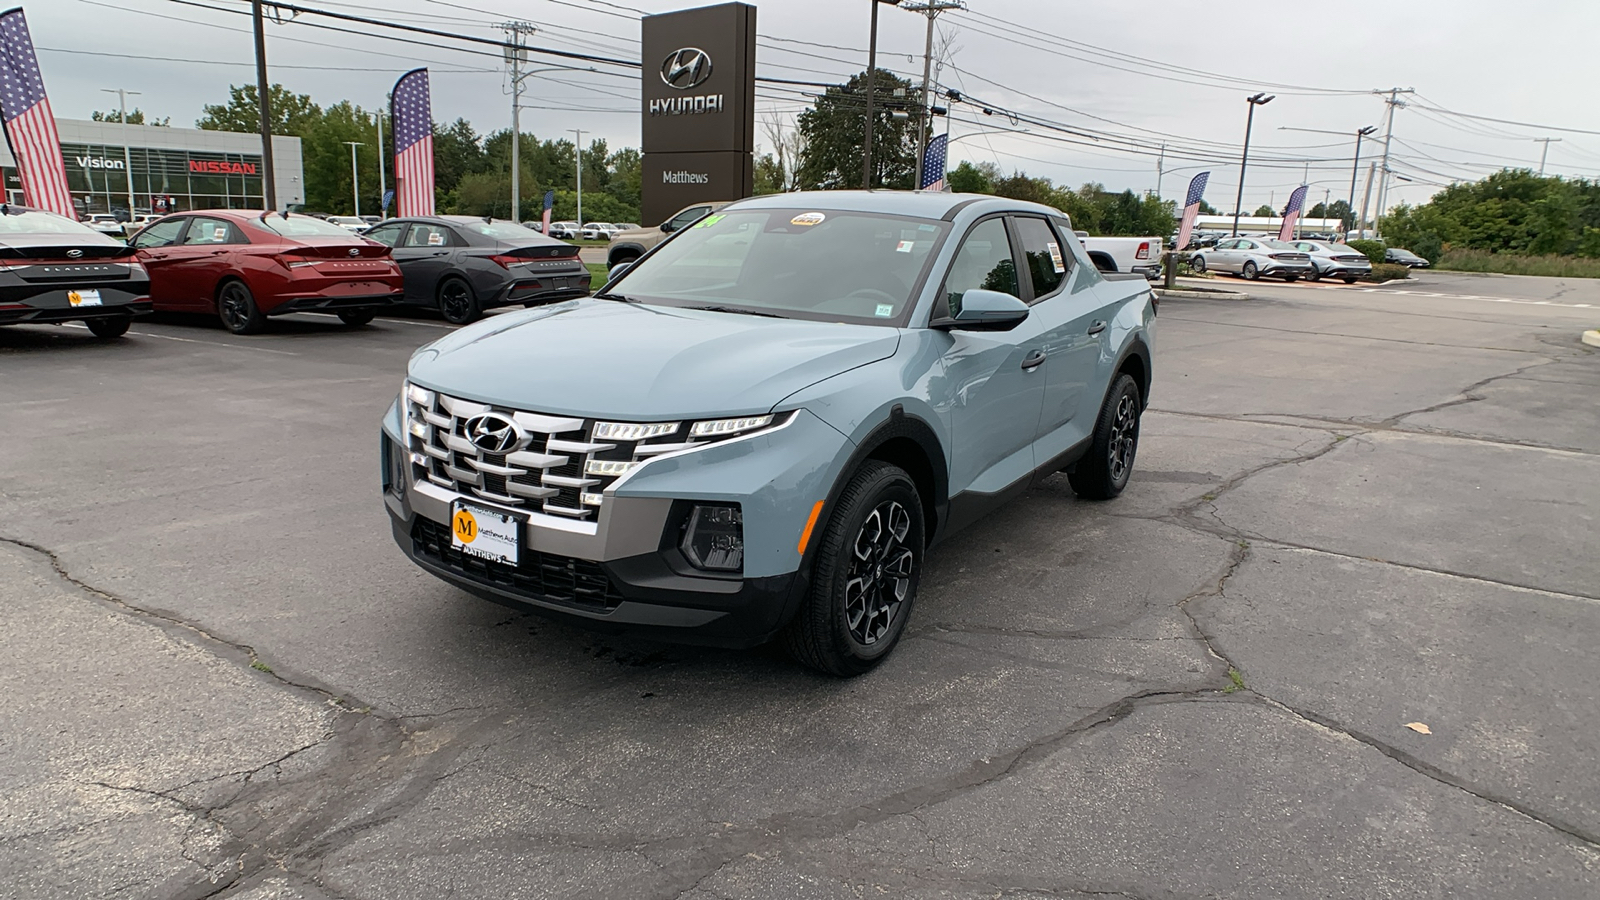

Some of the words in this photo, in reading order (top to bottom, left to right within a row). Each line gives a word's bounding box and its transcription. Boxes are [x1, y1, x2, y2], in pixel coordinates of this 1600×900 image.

[650, 94, 723, 114] HYUNDAI
[76, 156, 124, 169] Vision
[189, 160, 256, 174] NISSAN
[663, 170, 709, 184] Matthews
[457, 517, 473, 537] M
[478, 528, 504, 540] Matthews
[463, 547, 502, 563] MATTHEWS
